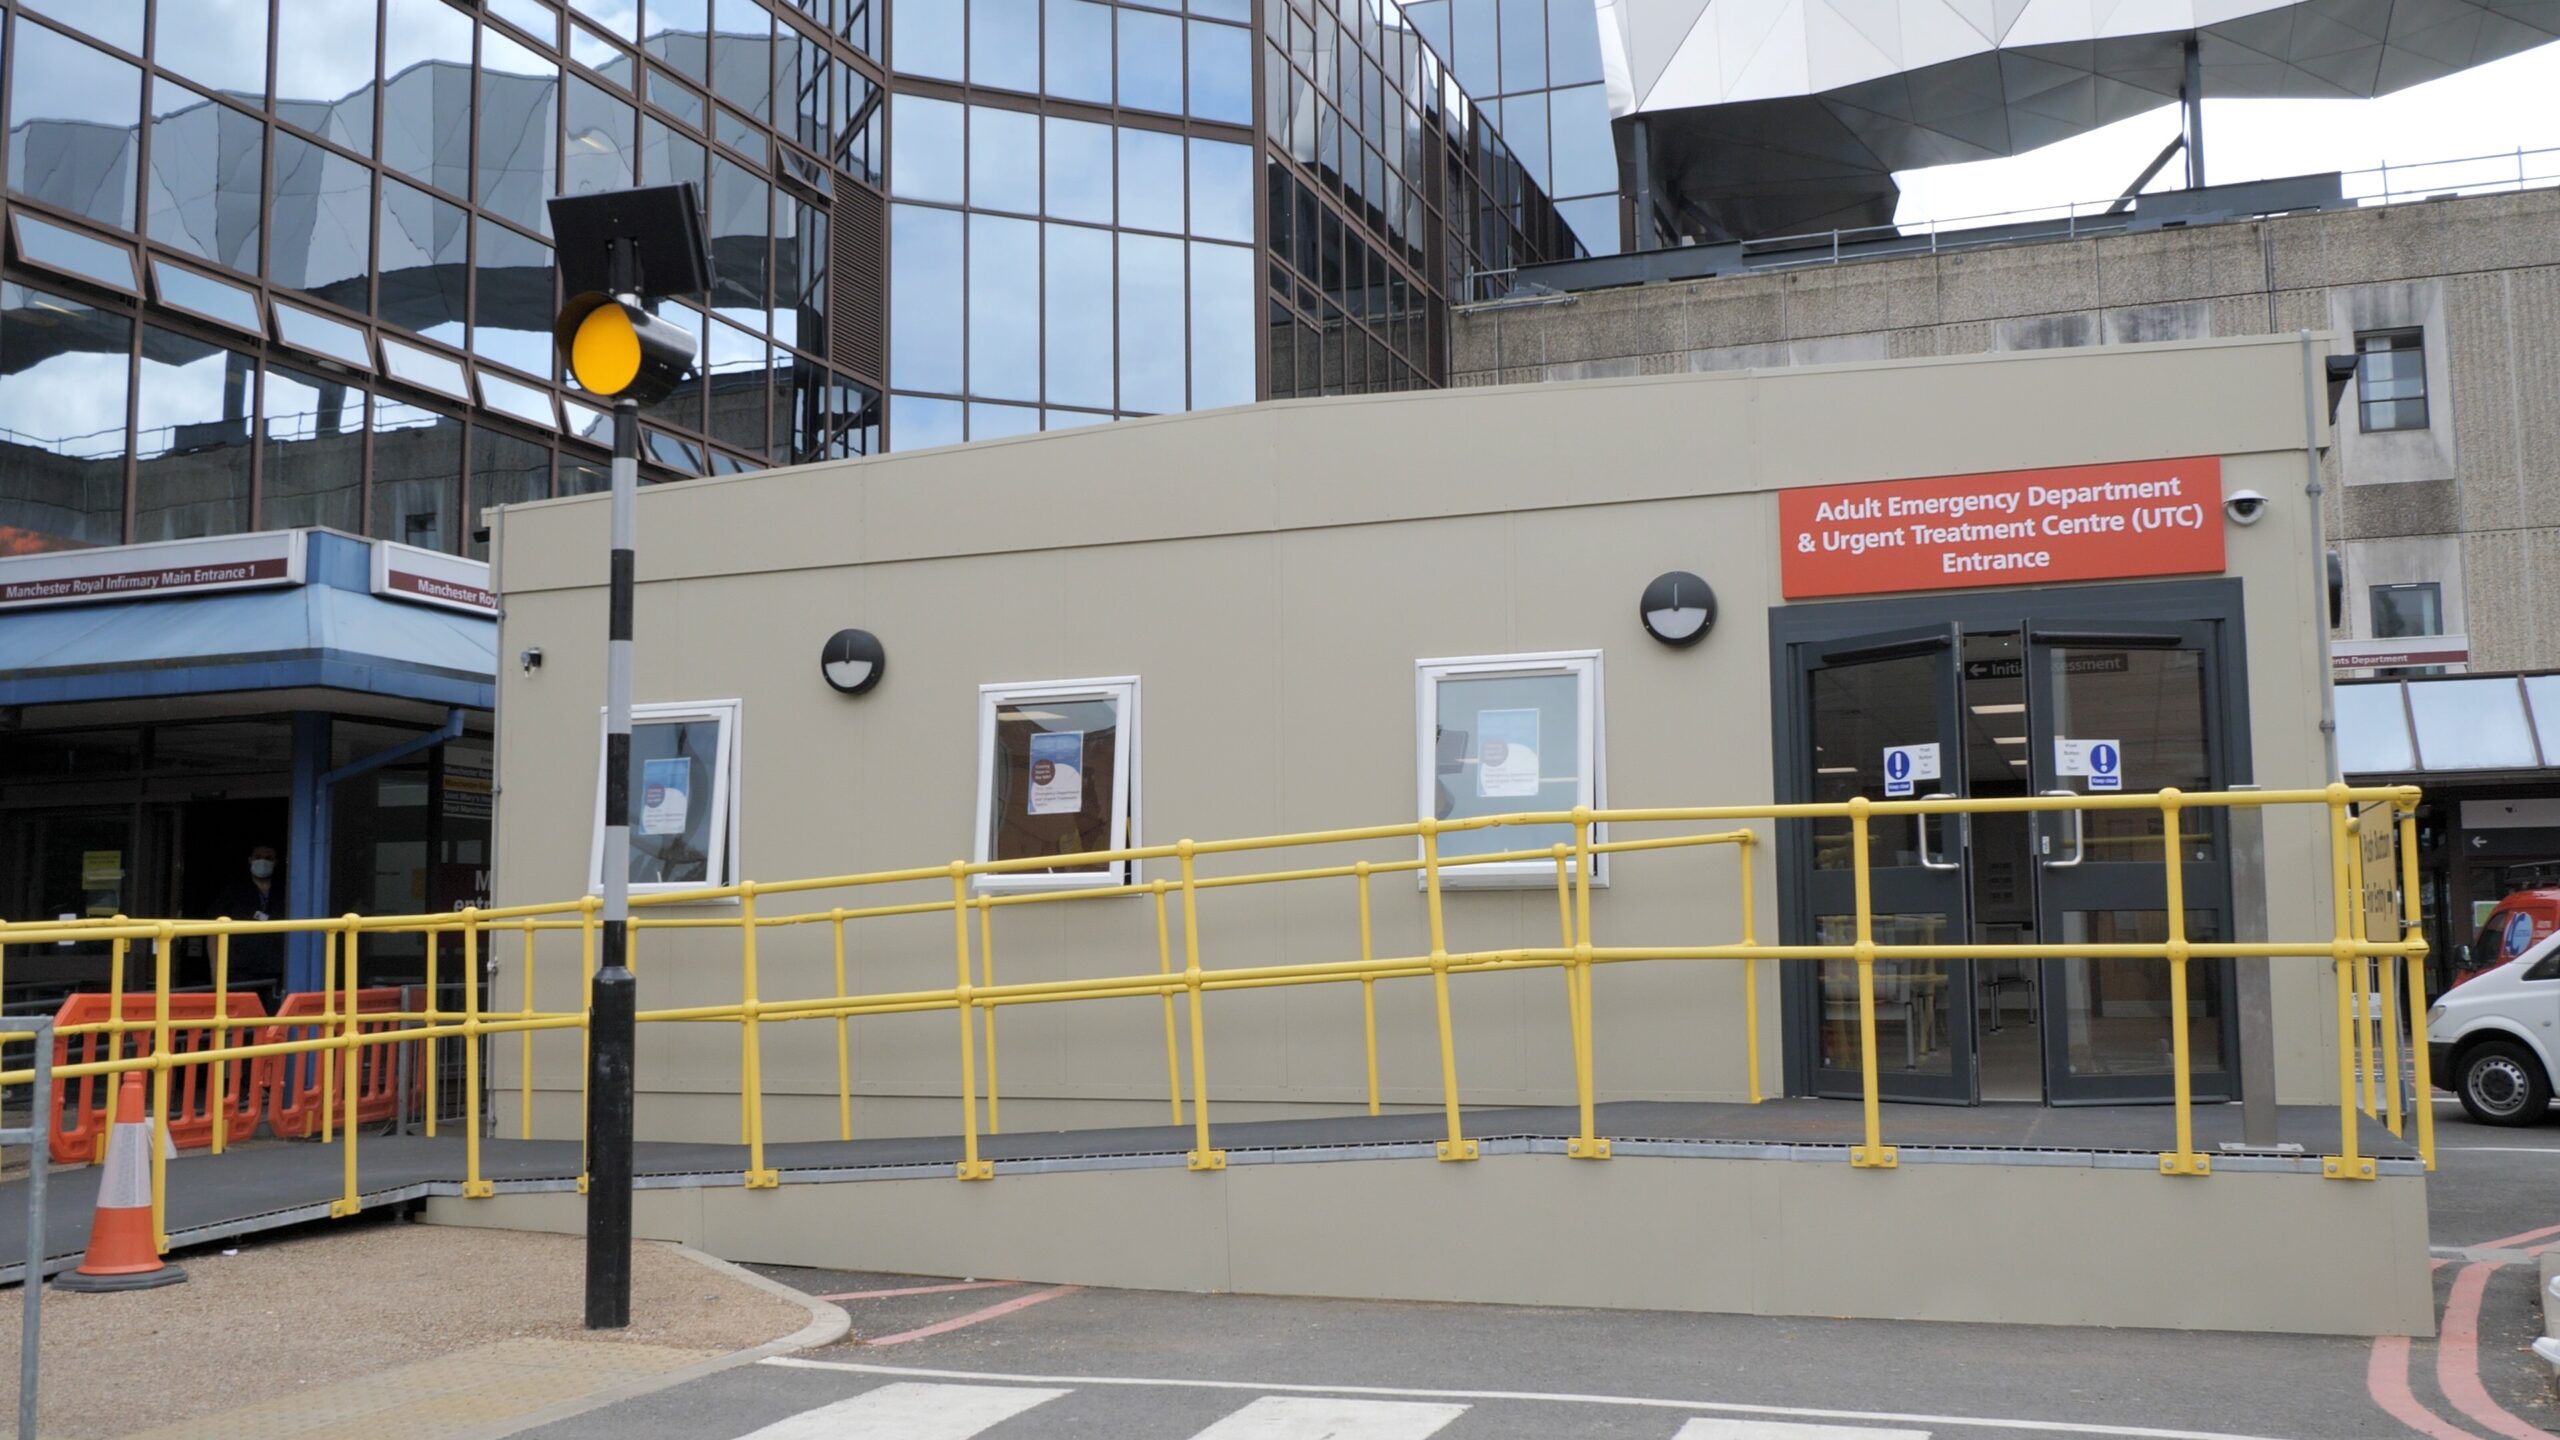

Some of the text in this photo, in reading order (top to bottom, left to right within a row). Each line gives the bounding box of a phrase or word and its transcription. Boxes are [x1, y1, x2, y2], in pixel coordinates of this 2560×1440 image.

[1815, 477, 2182, 522] Adult Emergency Department
[1798, 503, 2203, 555] & Urgent Treatment Centre (UTC)
[1943, 551, 2050, 573] Entrance
[6, 565, 255, 599] Manchester Royal Infirmary Main Entrance 1
[418, 579, 498, 608] Manchester Roy
[2351, 655, 2409, 665] Department
